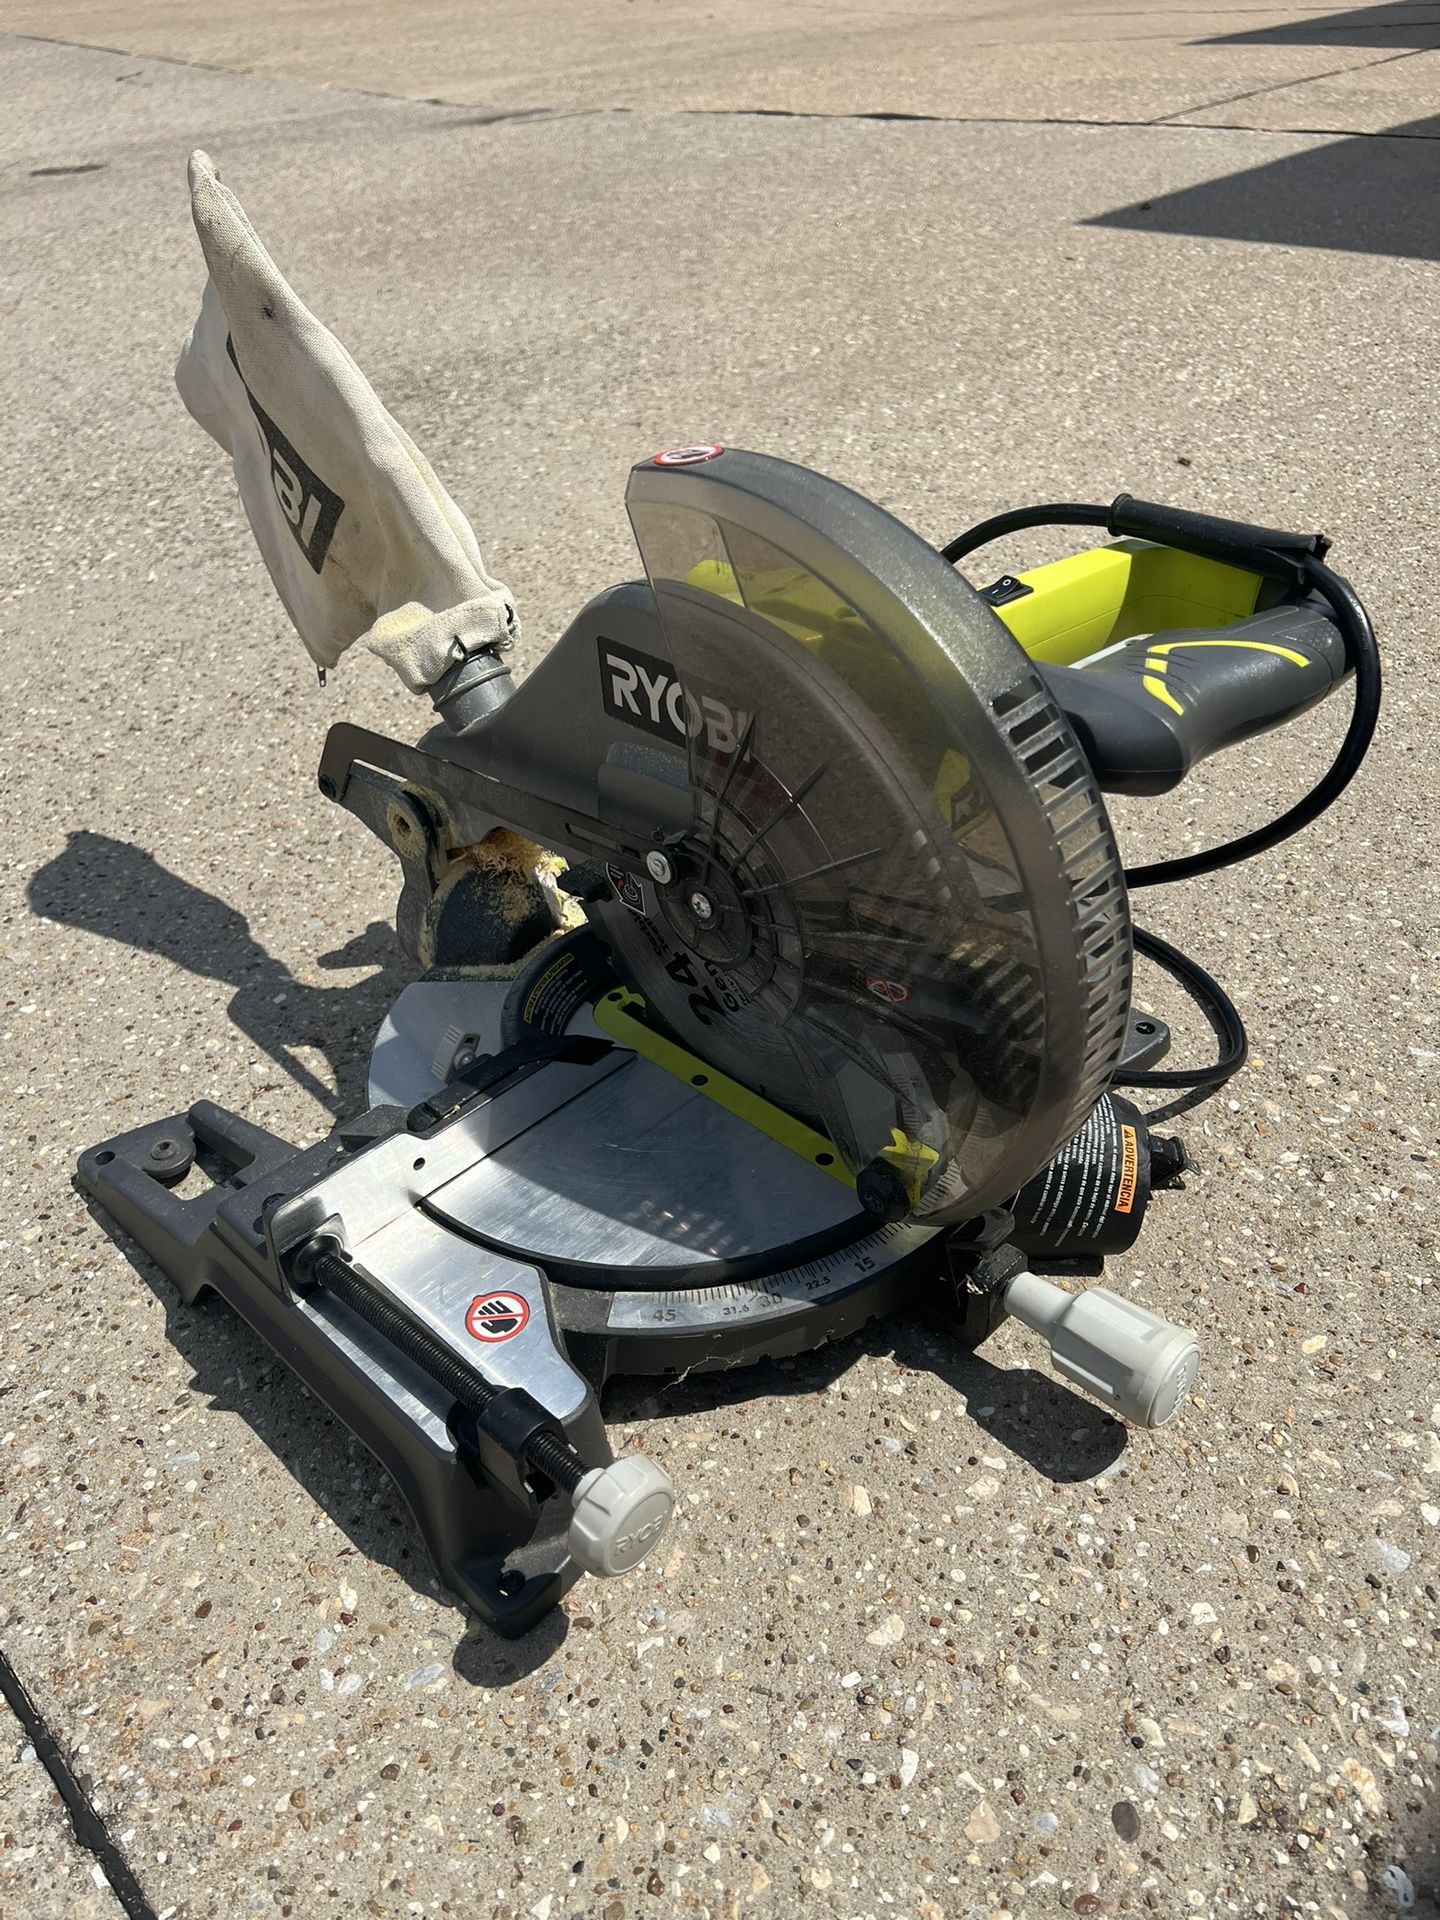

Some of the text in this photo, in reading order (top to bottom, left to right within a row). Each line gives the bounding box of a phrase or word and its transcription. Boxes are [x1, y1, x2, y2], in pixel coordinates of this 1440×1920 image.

[1118, 1141, 1135, 1208] ADVERTENCIA
[853, 1257, 877, 1273] 15
[805, 1276, 831, 1291] 22.5
[759, 1292, 783, 1308] 30
[653, 1309, 676, 1322] 45
[722, 1304, 750, 1316] 31.6
